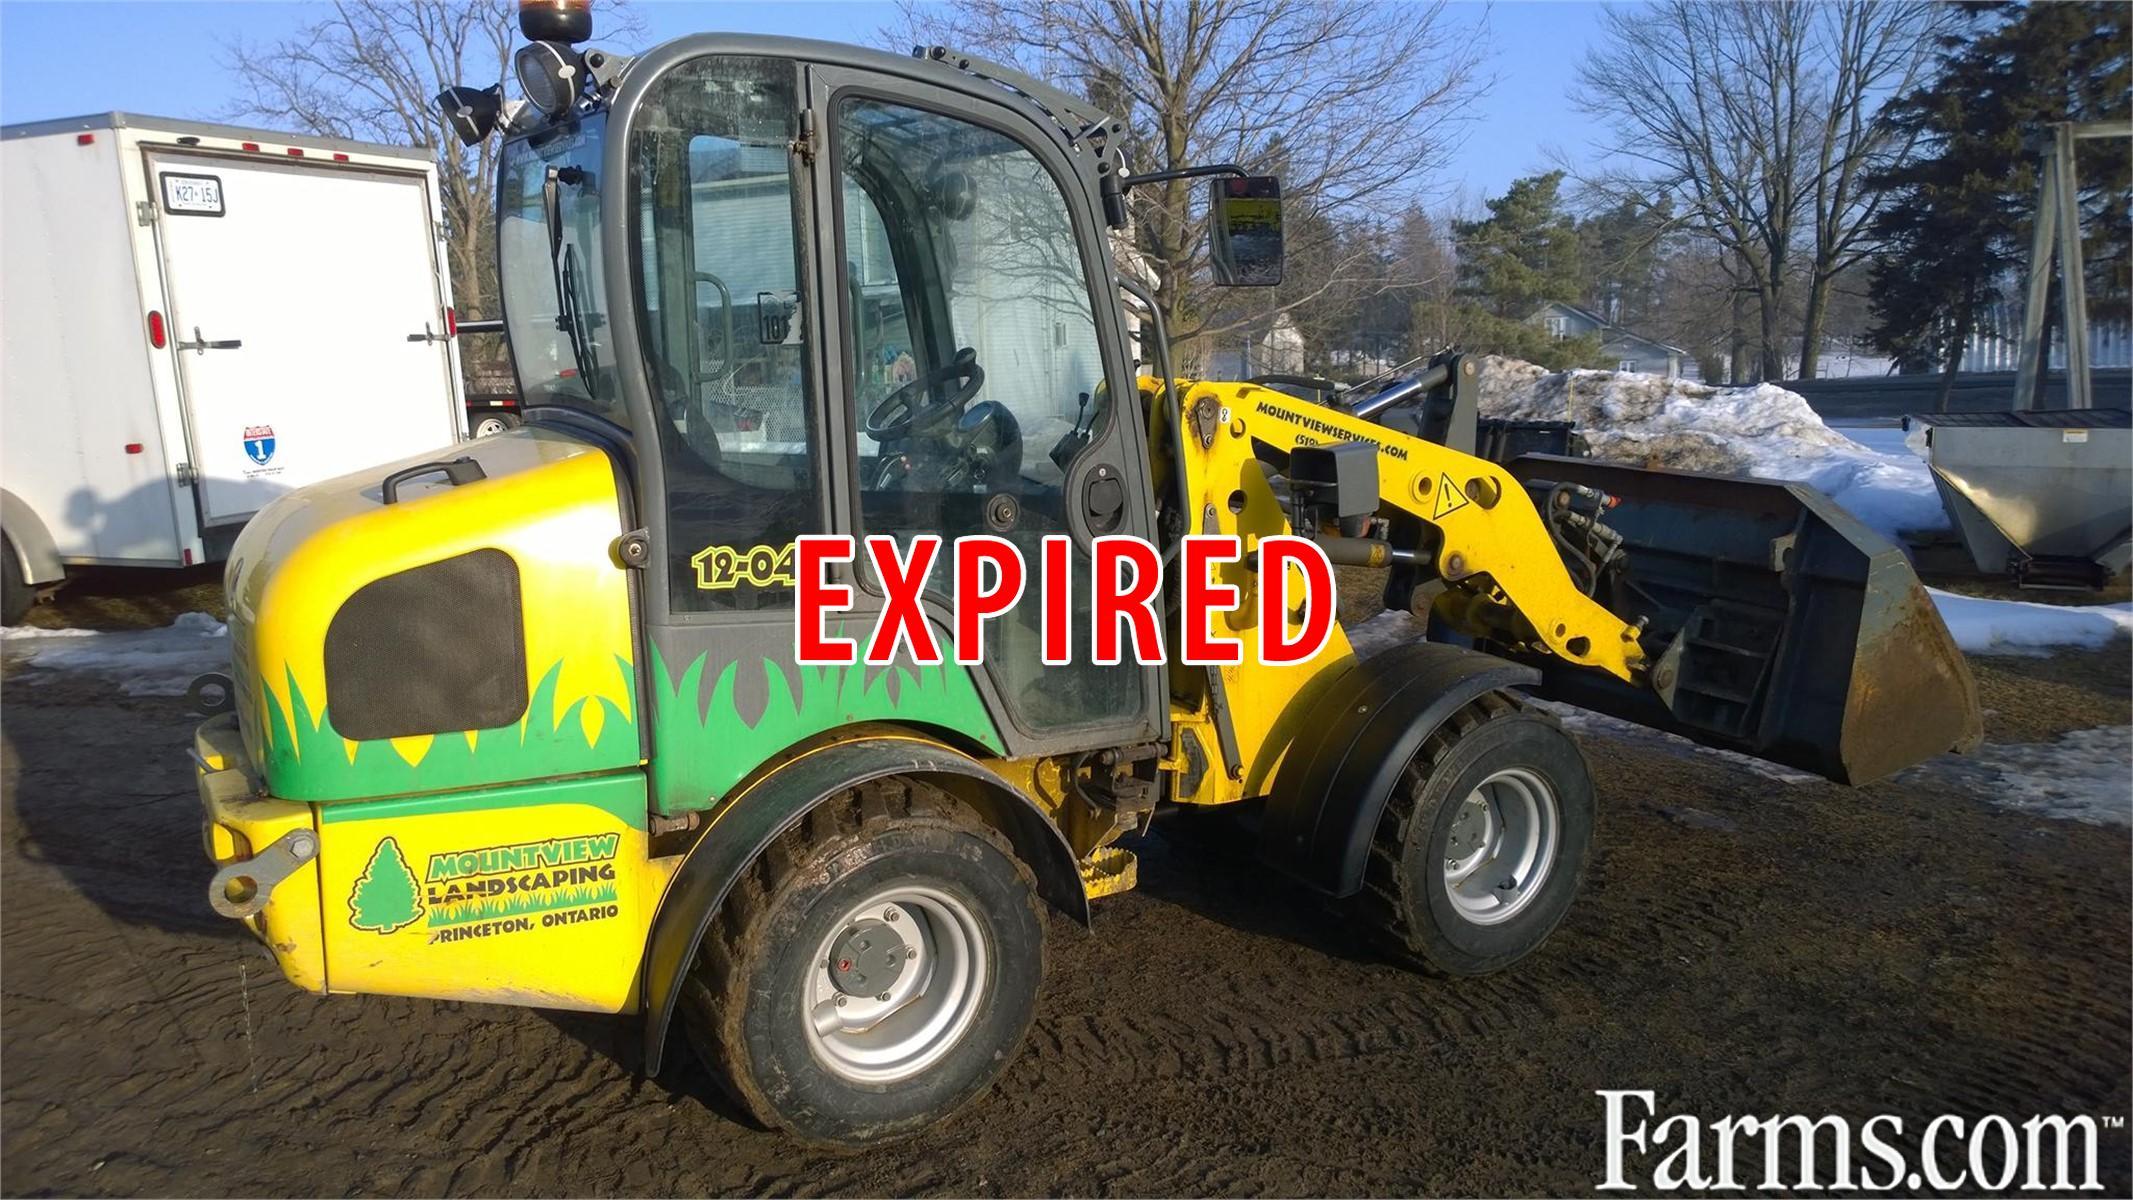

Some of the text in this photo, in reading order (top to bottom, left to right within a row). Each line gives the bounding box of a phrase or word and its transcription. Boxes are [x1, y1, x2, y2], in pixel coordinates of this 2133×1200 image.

[691, 543, 796, 589] 12-04
[425, 832, 621, 885] MOUNTVIEW
[427, 863, 616, 905] LANDSCAPING
[542, 904, 619, 927] ONTARIO
